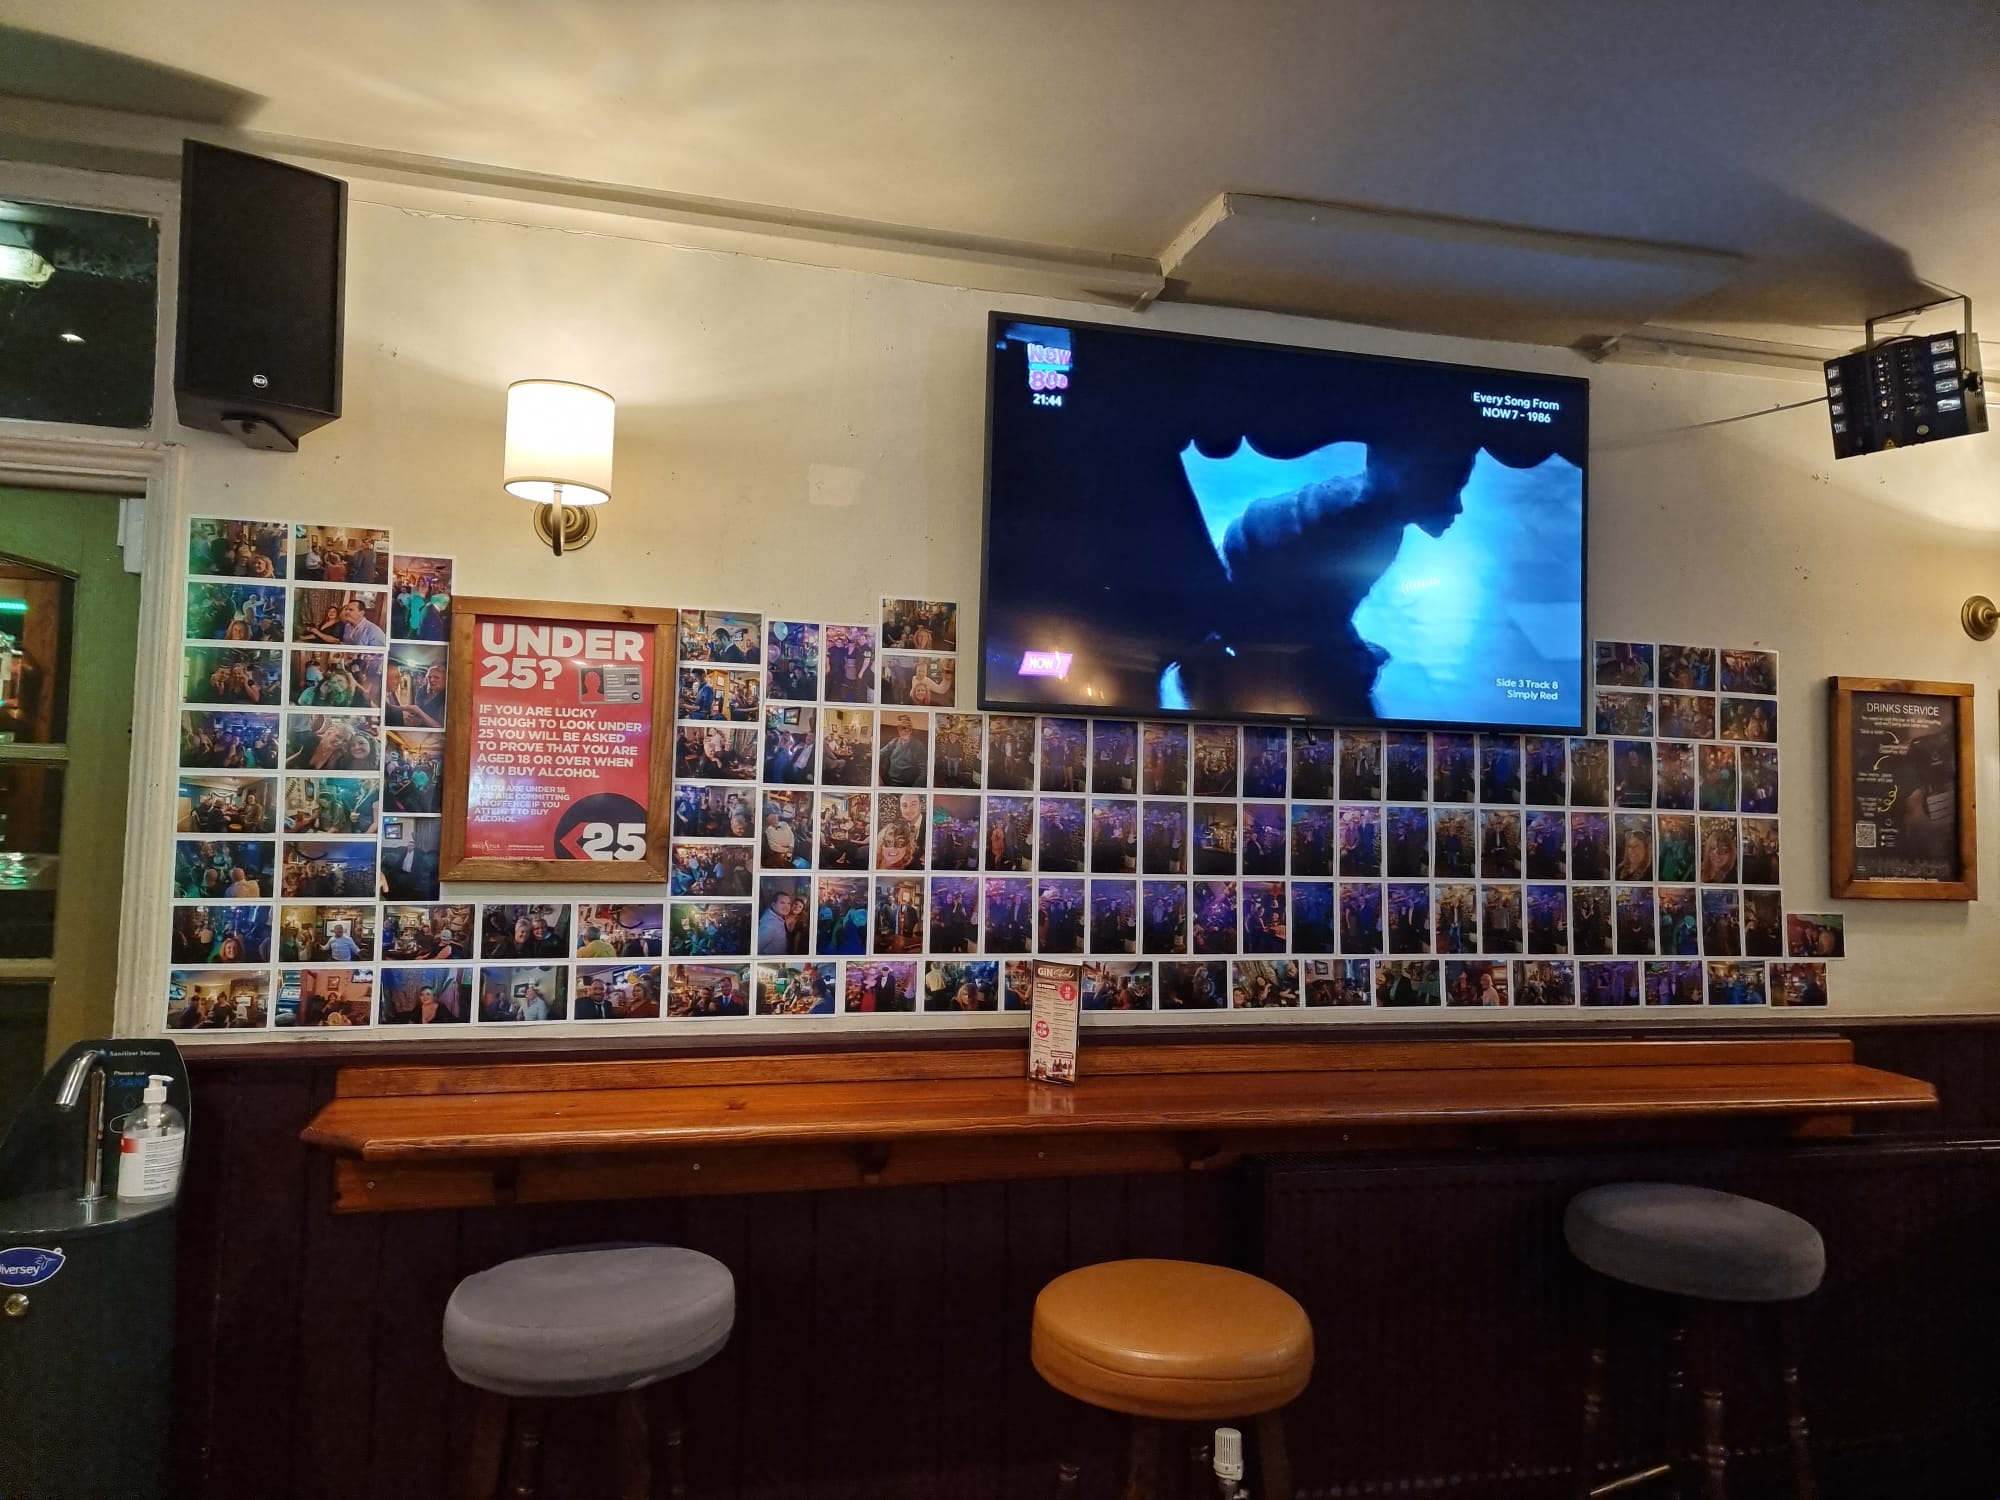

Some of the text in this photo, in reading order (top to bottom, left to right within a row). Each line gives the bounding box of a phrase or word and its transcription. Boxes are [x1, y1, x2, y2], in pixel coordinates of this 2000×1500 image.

[1027, 342, 1071, 364] NOW
[1032, 393, 1062, 406] 21:44
[1473, 392, 1560, 410] Every Song From
[1526, 411, 1551, 423] 1986
[481, 622, 645, 662] UNDER
[480, 656, 563, 690] 25?
[1495, 678, 1517, 688] Side
[1518, 679, 1524, 688] 3
[1525, 679, 1550, 689] Track
[1507, 689, 1559, 700] Simply Red
[479, 704, 597, 718] IF YOU ARE LUCKY
[1866, 702, 1940, 717] DRINKS SERVICE
[478, 716, 642, 732] ENOUGH TO LOOK UNDER
[478, 728, 626, 744] 25 YOU WILL BE ASKED
[477, 740, 639, 756] TO PROVE THAT YOU ARE
[477, 753, 634, 767] AGED 18 OR OVER WHEN
[477, 765, 505, 776] YOU
[508, 766, 536, 776] BUY
[525, 785, 555, 793] UNDER
[515, 793, 570, 801] COMMITTING
[1037, 967, 1054, 977] GIN
